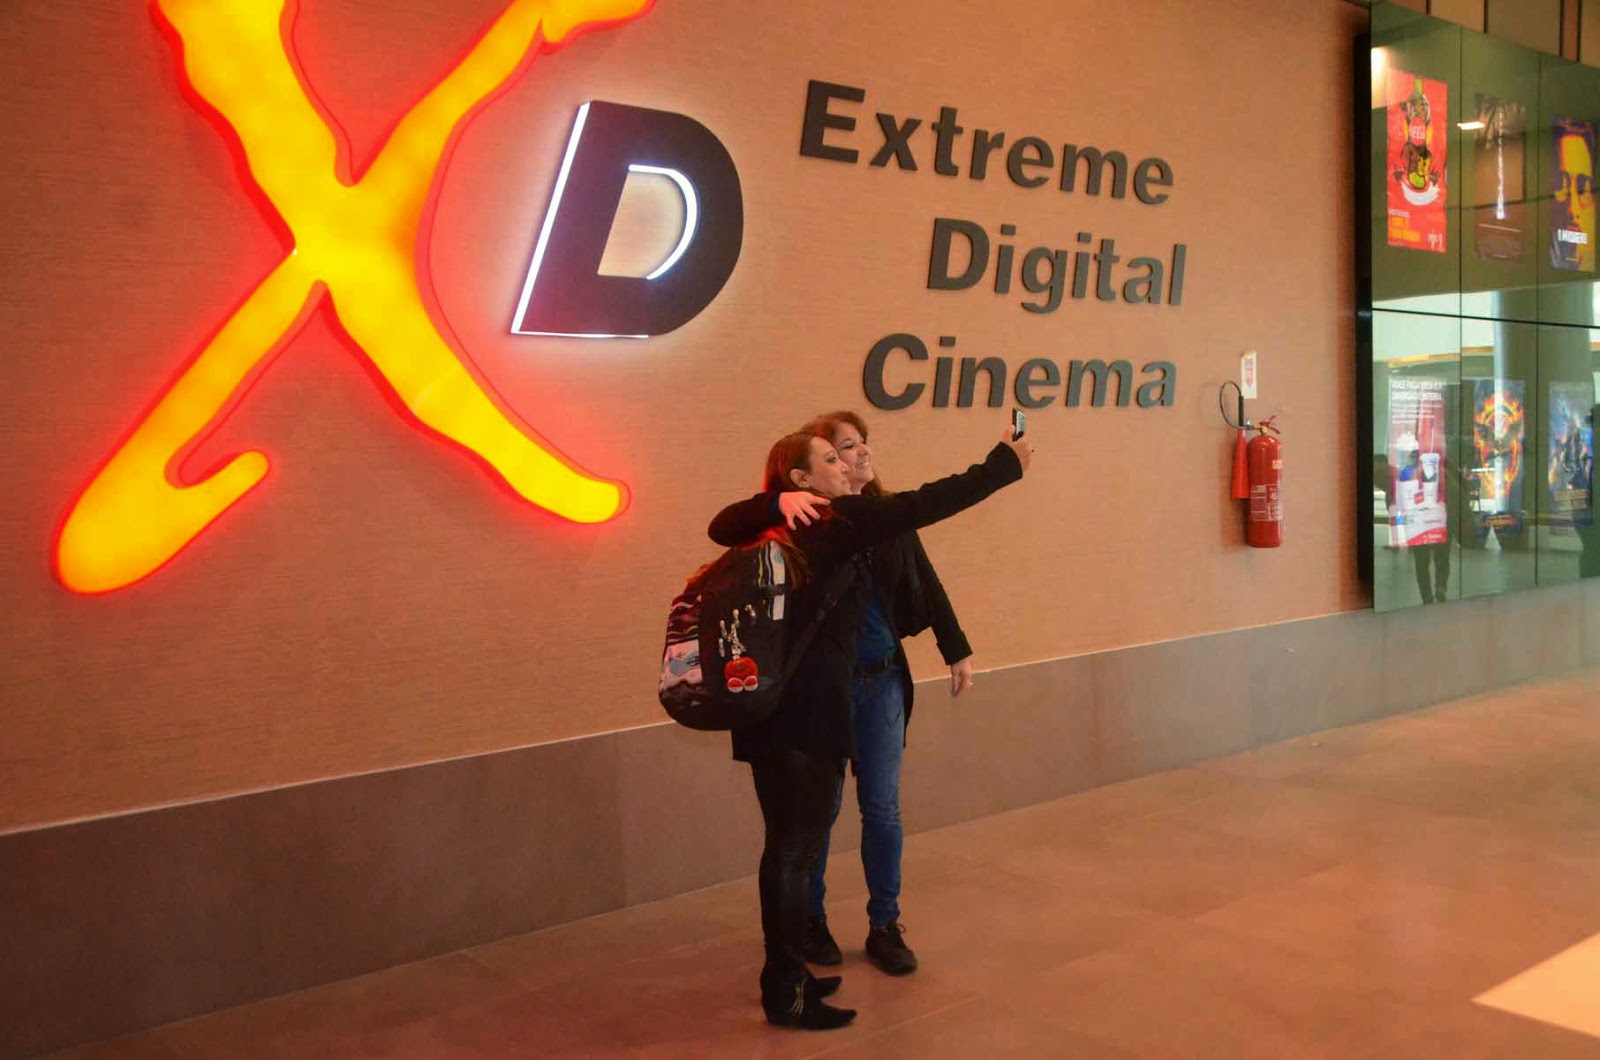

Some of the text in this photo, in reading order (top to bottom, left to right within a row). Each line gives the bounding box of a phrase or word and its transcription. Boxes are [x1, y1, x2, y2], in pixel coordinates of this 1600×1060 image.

[800, 79, 1174, 205] Extreme
[927, 217, 1187, 314] Digital
[862, 333, 1178, 410] Cinema
